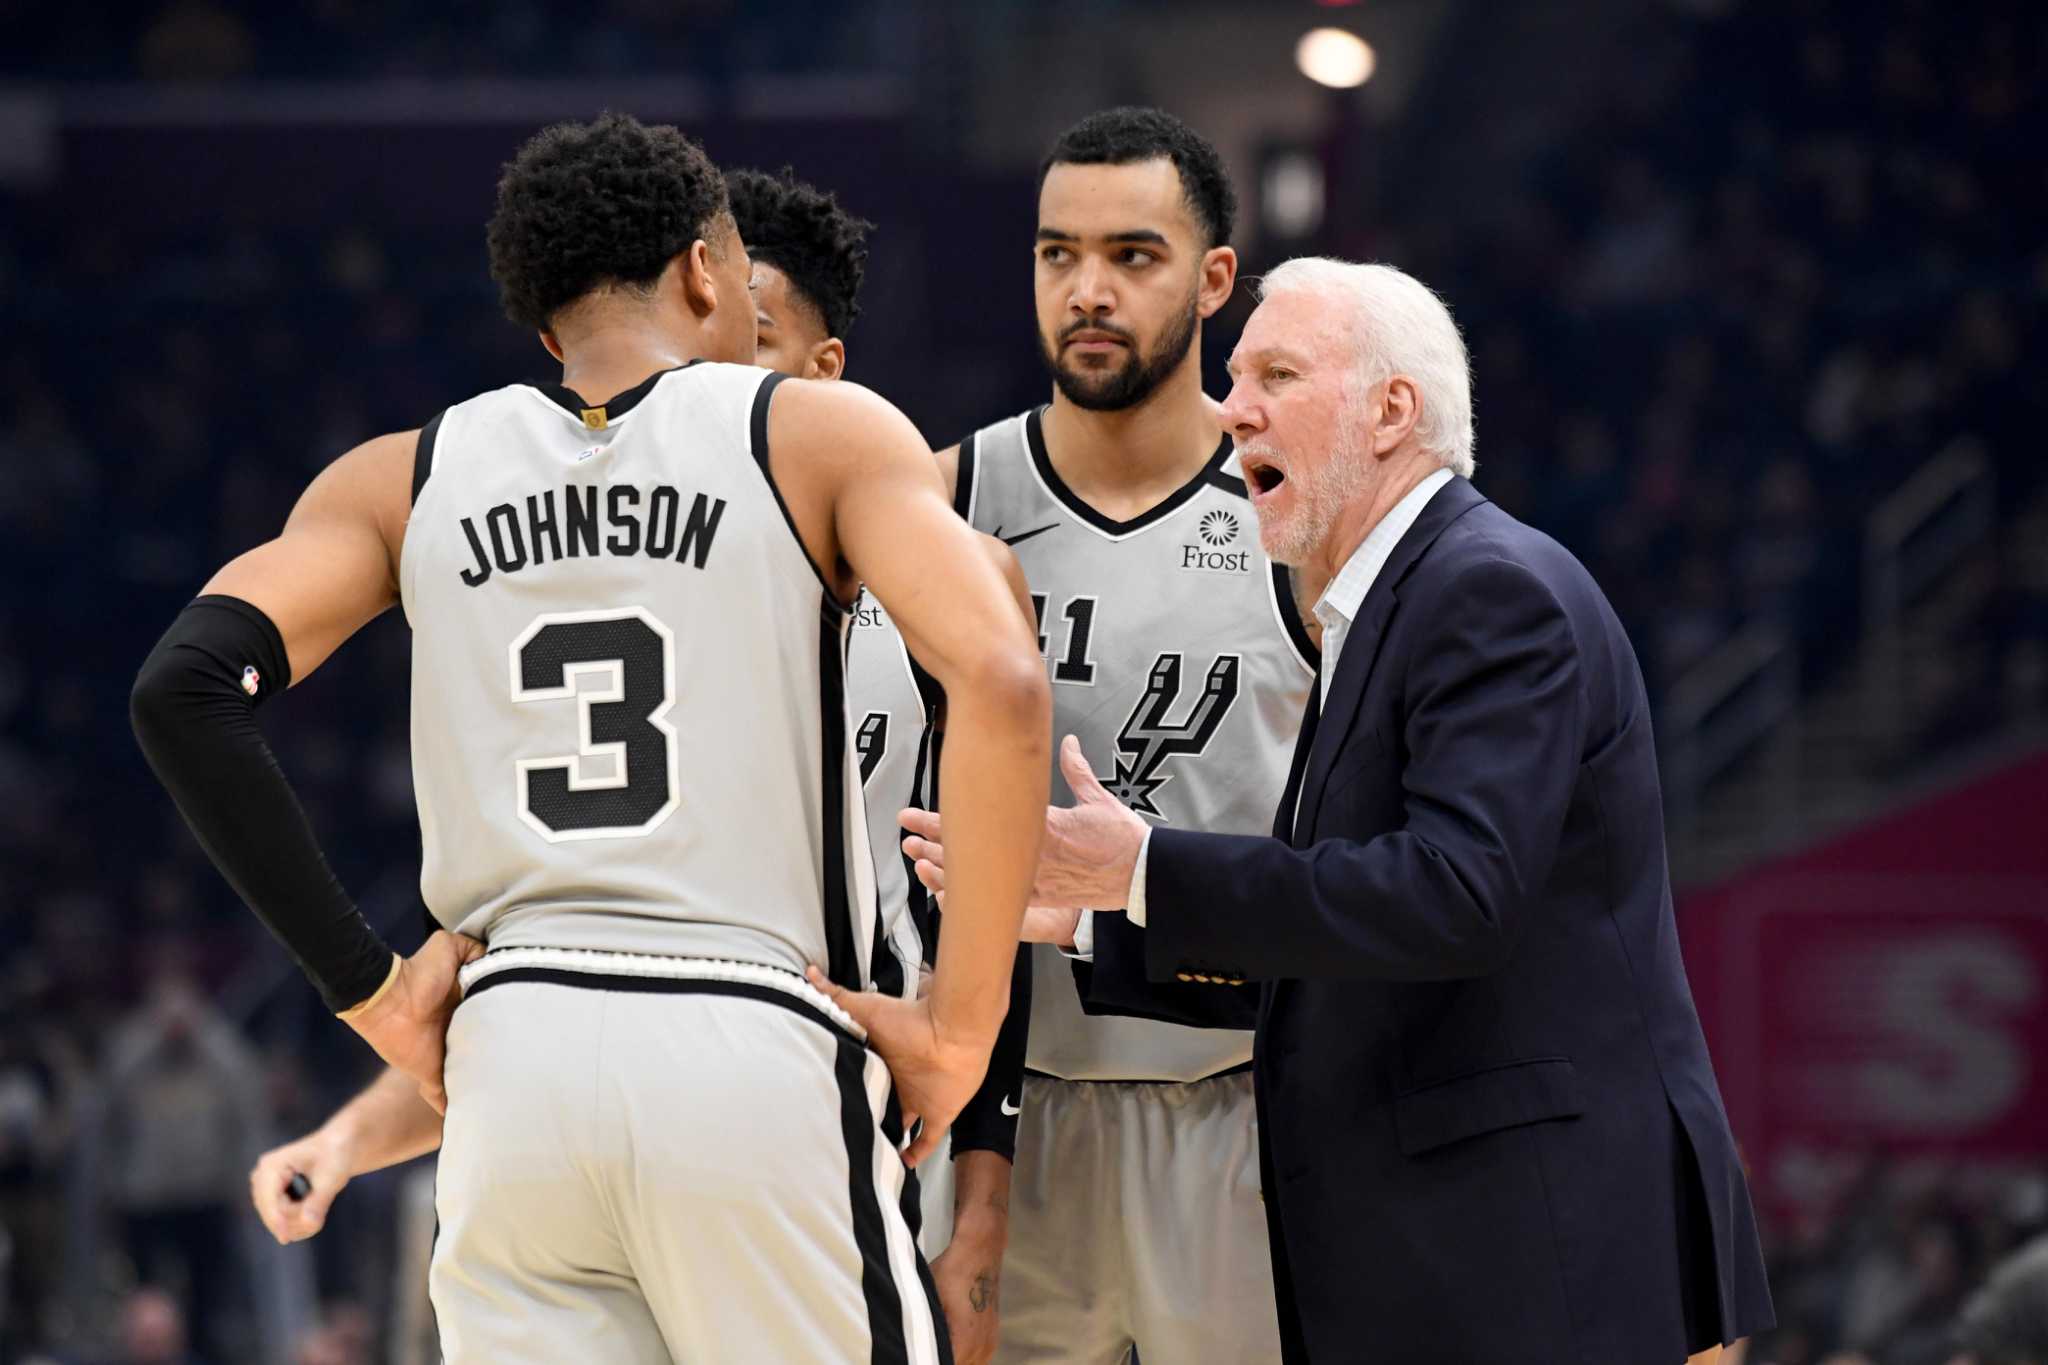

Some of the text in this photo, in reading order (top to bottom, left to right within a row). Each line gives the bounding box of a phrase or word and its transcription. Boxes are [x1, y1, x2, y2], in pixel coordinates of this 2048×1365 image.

[459, 484, 728, 588] JOHNSON
[1181, 545, 1250, 572] Frost
[508, 606, 680, 843] 3
